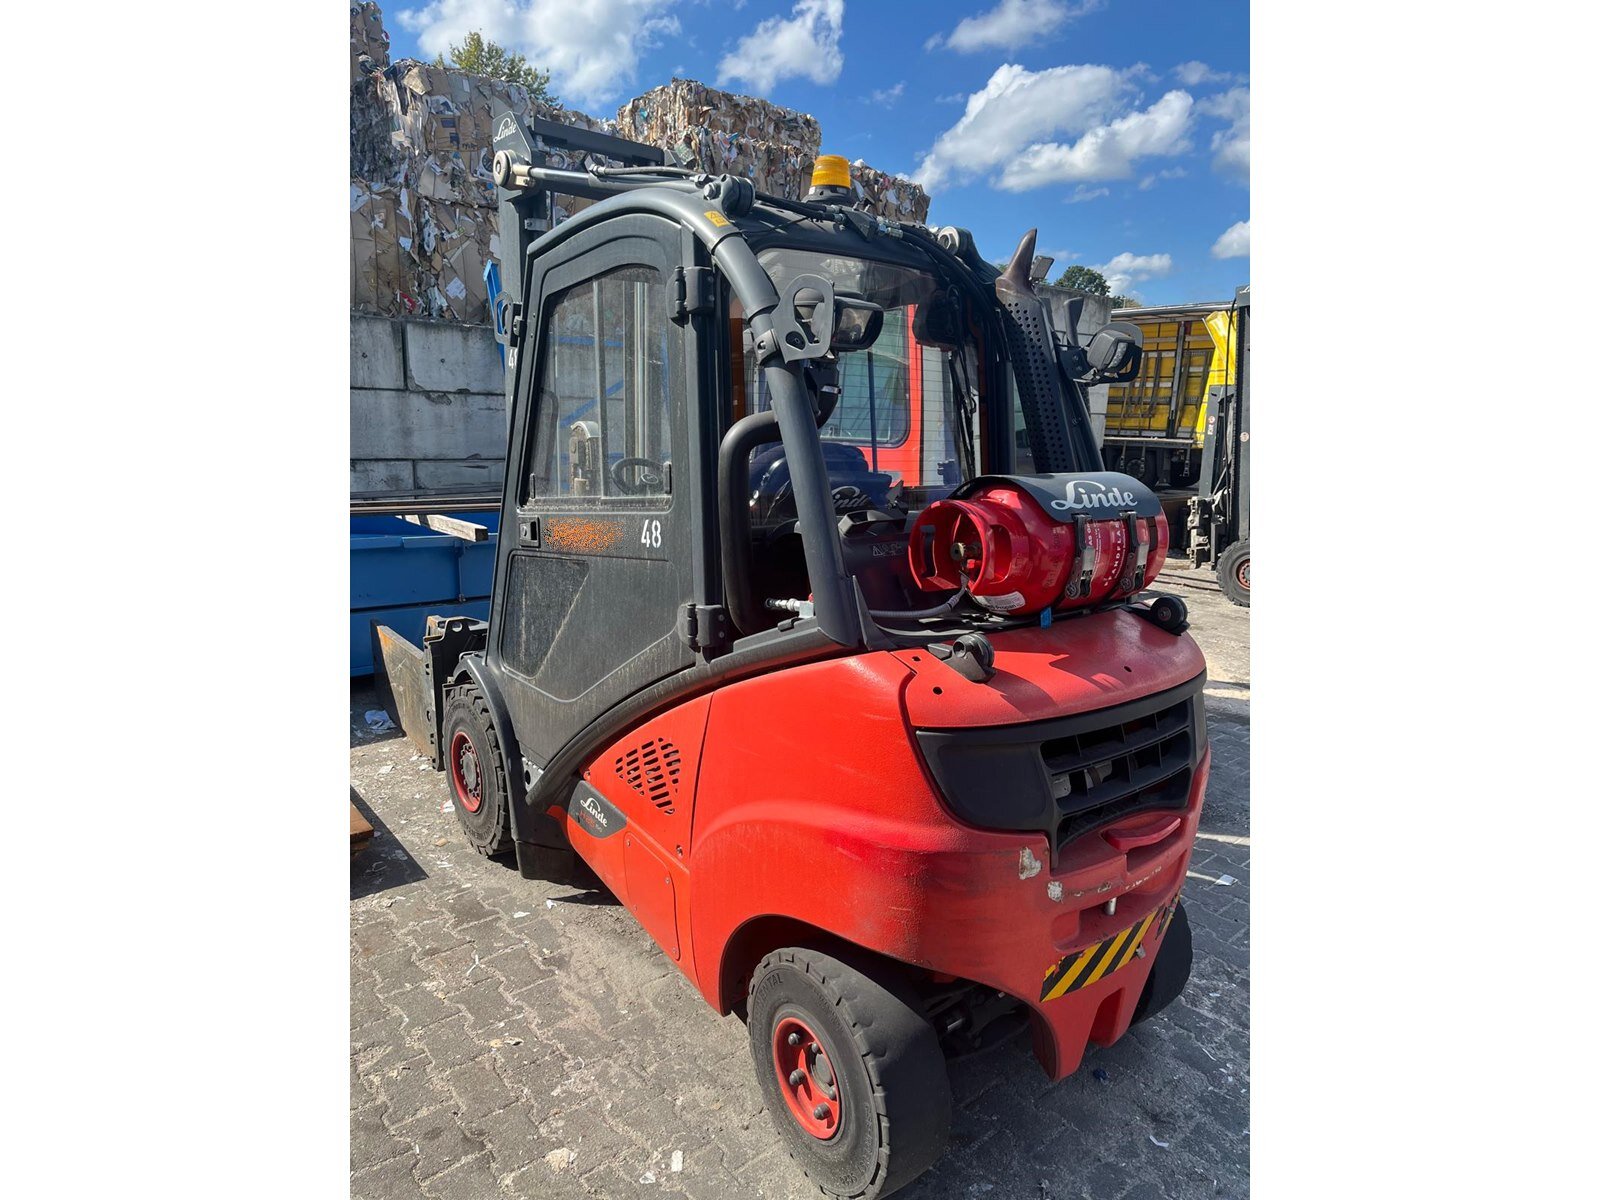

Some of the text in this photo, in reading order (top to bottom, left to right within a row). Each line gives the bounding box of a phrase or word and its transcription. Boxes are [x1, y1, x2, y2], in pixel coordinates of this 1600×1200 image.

[493, 118, 517, 142] Linde
[1050, 480, 1138, 511] Linde
[640, 519, 662, 549] 48
[580, 797, 607, 827] Linde
